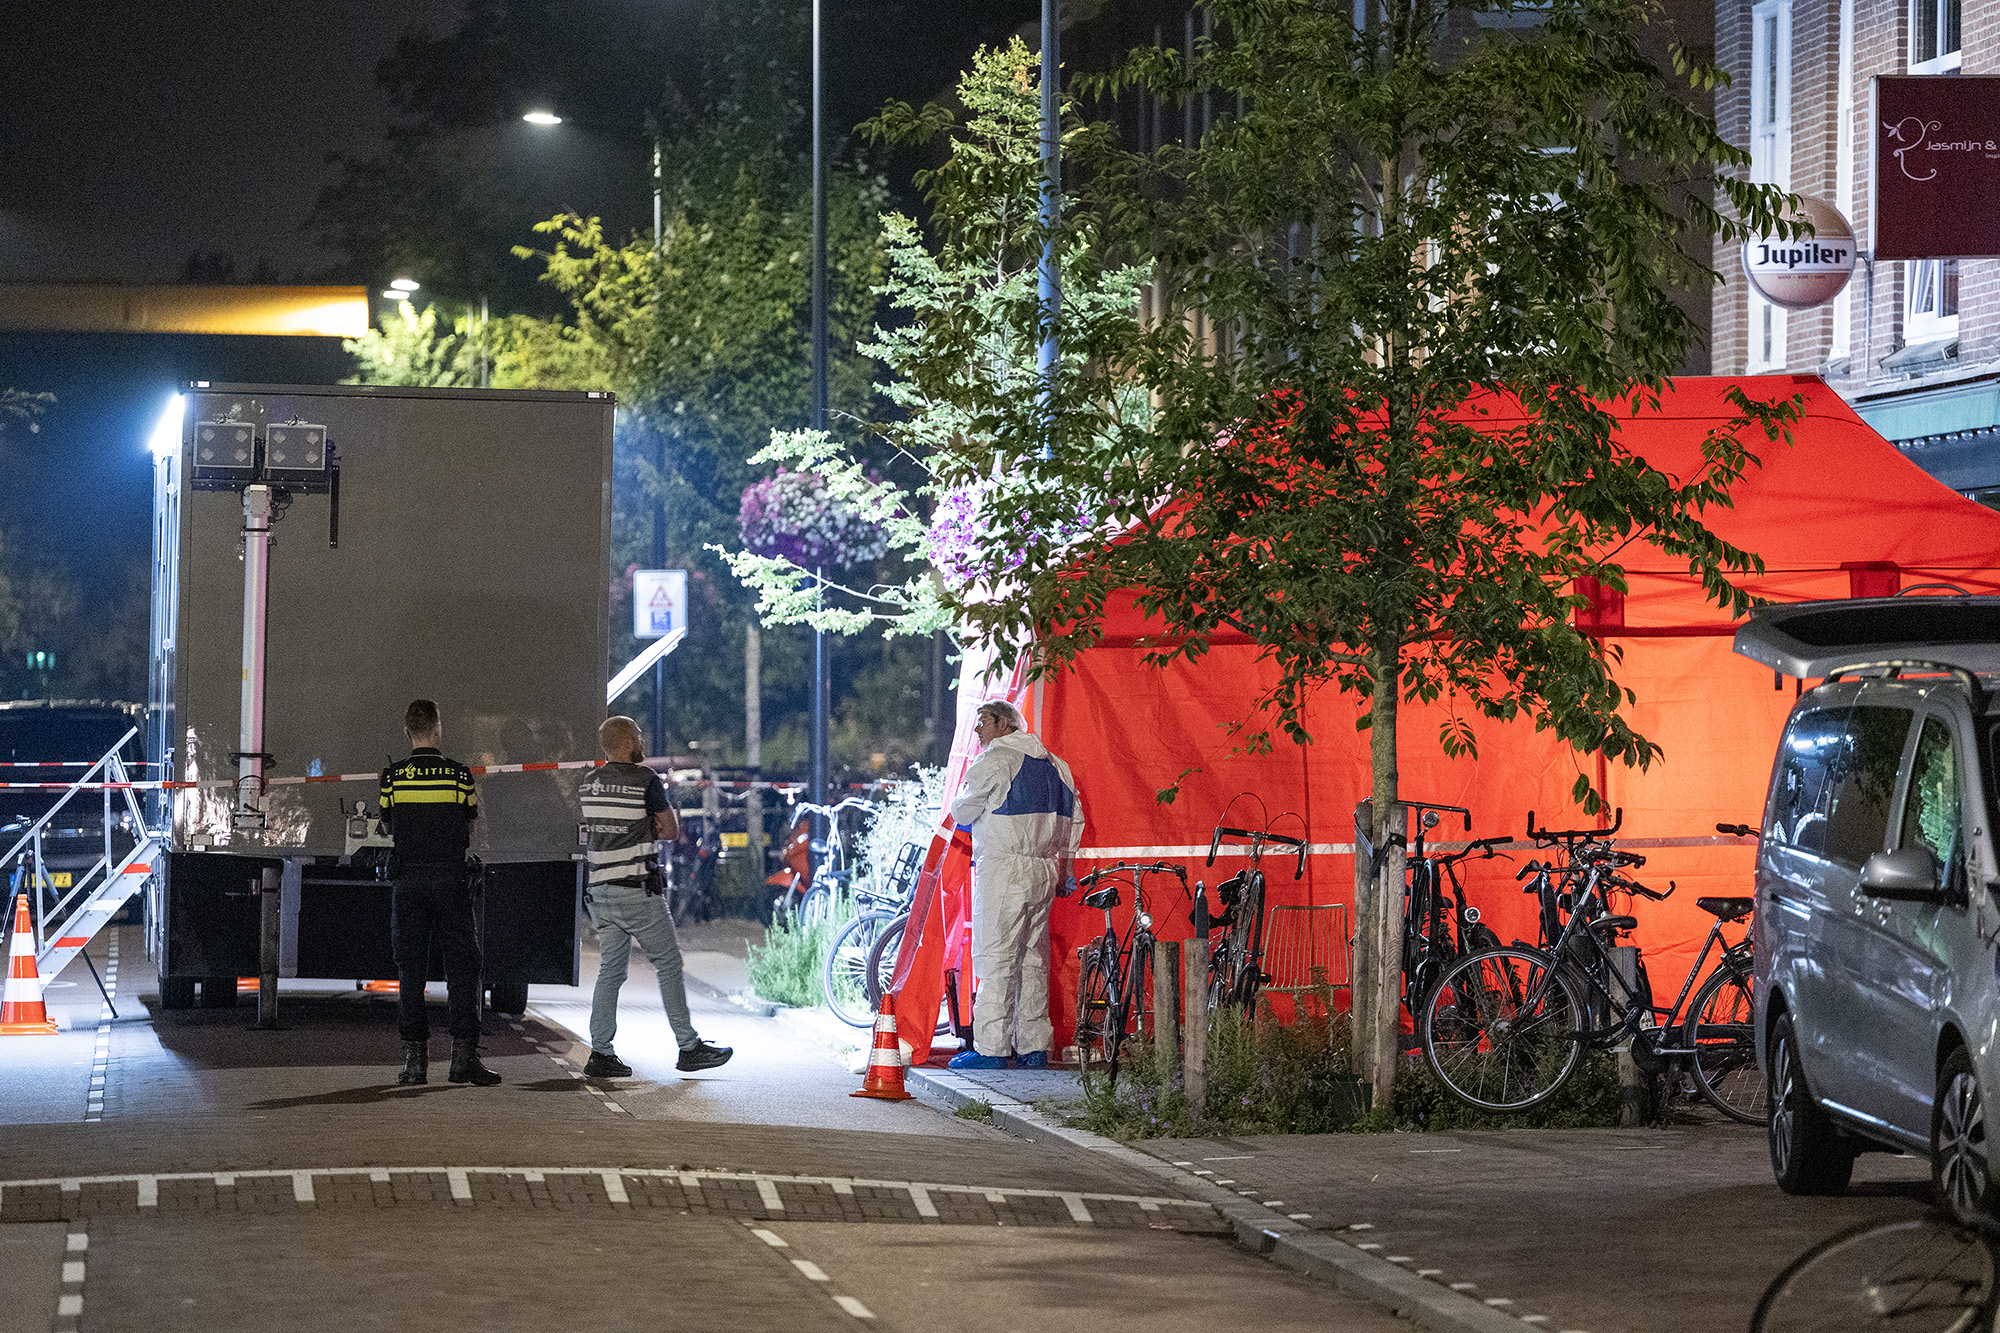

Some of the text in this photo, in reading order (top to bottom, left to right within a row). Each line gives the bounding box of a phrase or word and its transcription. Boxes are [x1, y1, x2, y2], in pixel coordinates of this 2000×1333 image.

[1925, 140, 1997, 152] Jasmijn &
[1755, 243, 1847, 269] Jupiler
[398, 764, 451, 779] POLITIE
